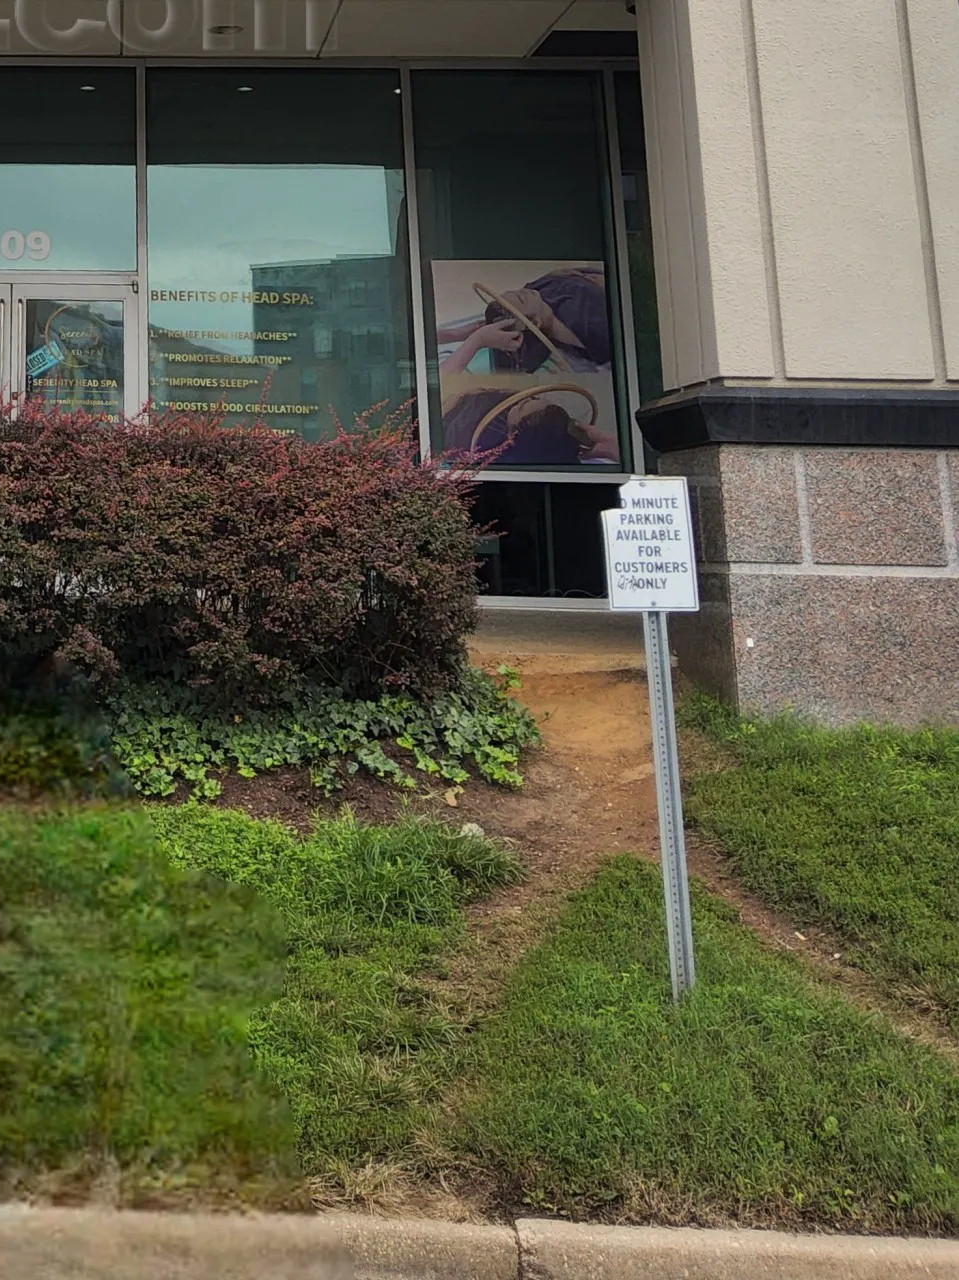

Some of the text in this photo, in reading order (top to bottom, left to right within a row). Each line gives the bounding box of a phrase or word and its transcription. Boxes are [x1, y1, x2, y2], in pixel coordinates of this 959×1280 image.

[151, 290, 315, 305] BENEFITS OF HEAD SPA:
[75, 379, 99, 387] HEAD
[100, 380, 118, 388] SPA
[631, 497, 679, 509] MINUTE
[620, 513, 674, 525] PARKING
[616, 529, 682, 541] AVAILABLE
[638, 545, 662, 557] FOR
[614, 561, 688, 573] CUSTOMERS
[637, 577, 668, 589] ONLY
